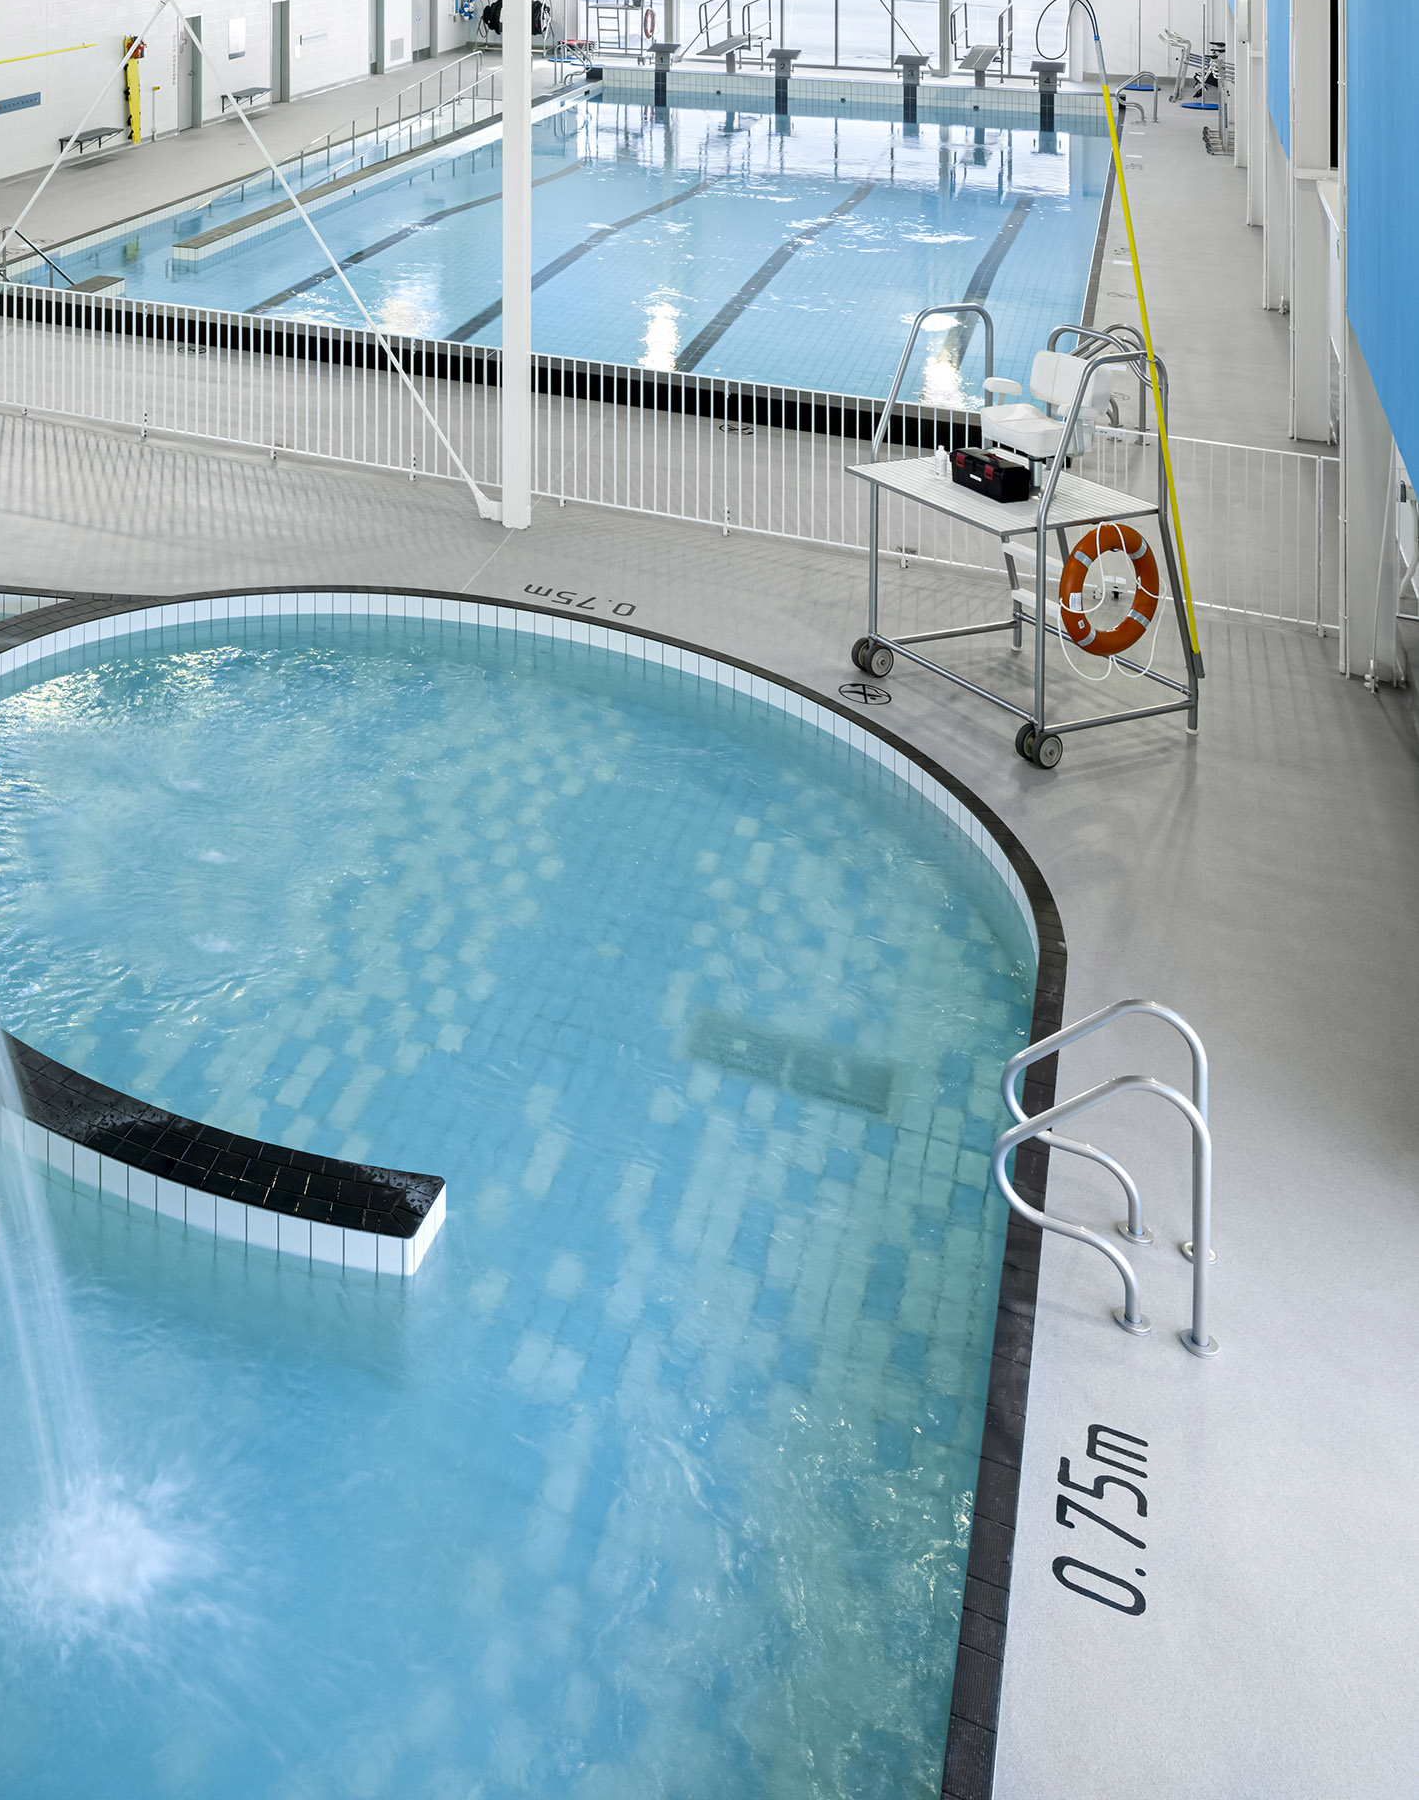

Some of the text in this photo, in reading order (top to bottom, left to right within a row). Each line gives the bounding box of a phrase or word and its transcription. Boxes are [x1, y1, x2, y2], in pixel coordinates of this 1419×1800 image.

[780, 62, 786, 70] 2
[908, 69, 915, 77] 3
[1044, 76, 1051, 84] 4
[523, 584, 637, 617] 0.75m
[1051, 1423, 1149, 1617] 0.75m
